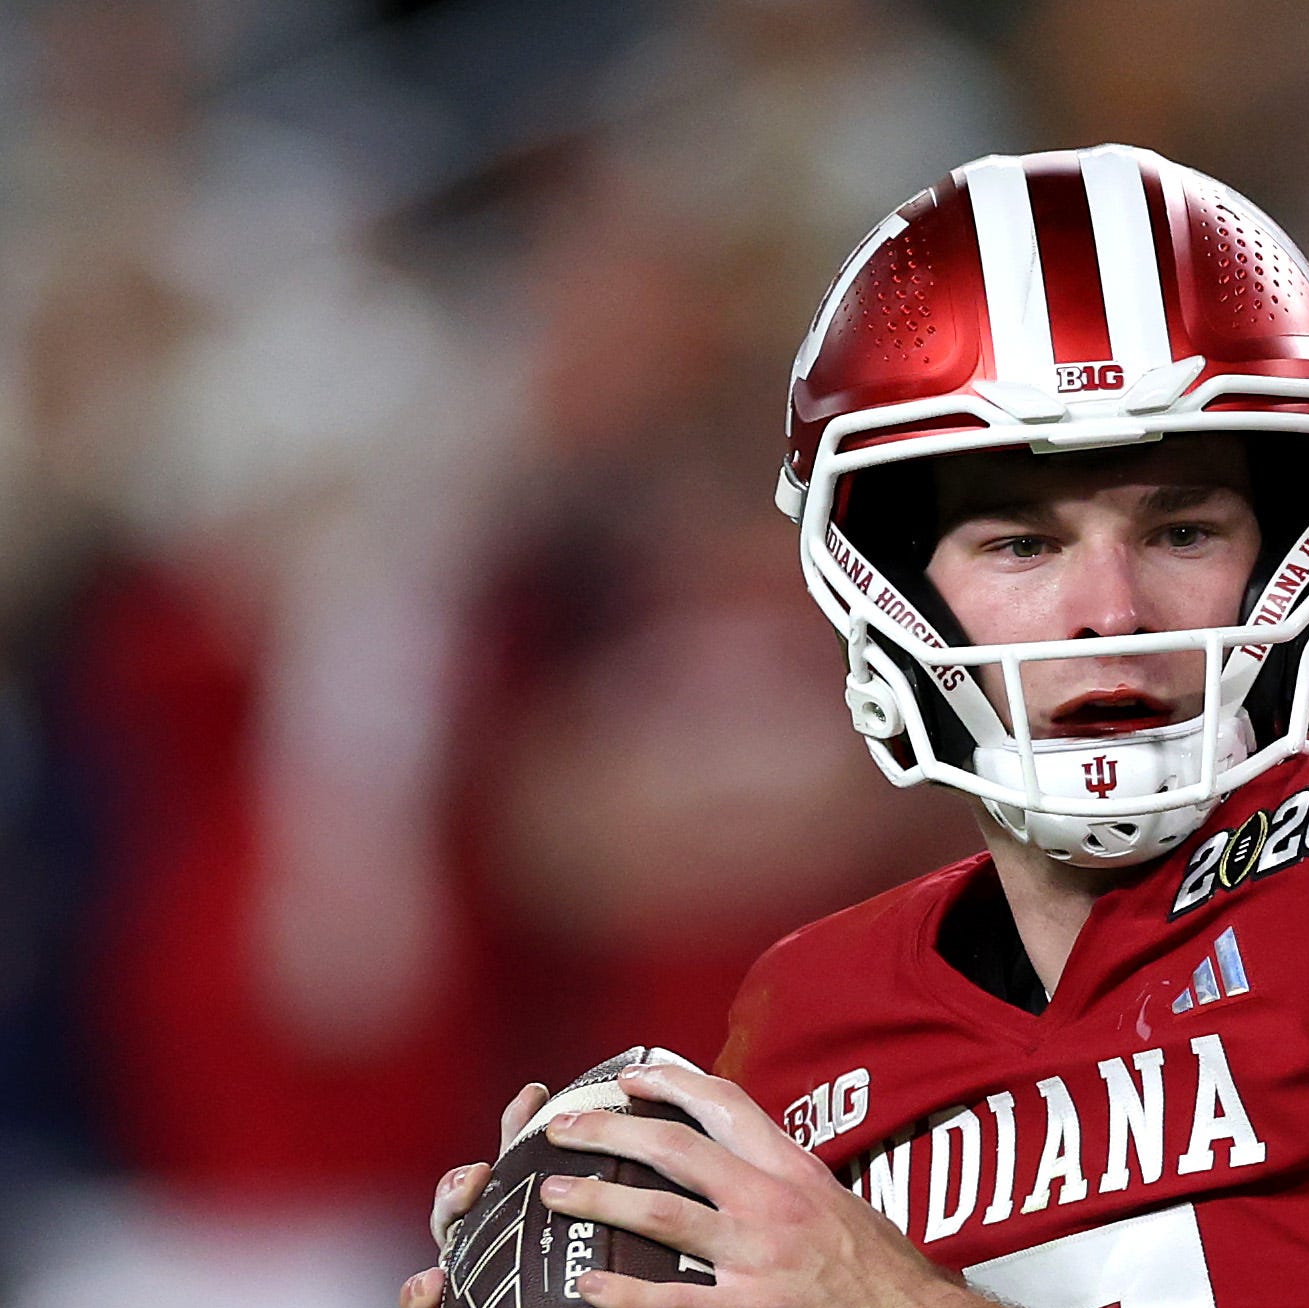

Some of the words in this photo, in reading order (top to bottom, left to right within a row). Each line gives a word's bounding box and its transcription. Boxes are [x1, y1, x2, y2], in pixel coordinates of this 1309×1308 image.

[826, 527, 875, 596] DIANA
[851, 1033, 1266, 1243] NDIANA
[540, 1227, 554, 1255] USA
